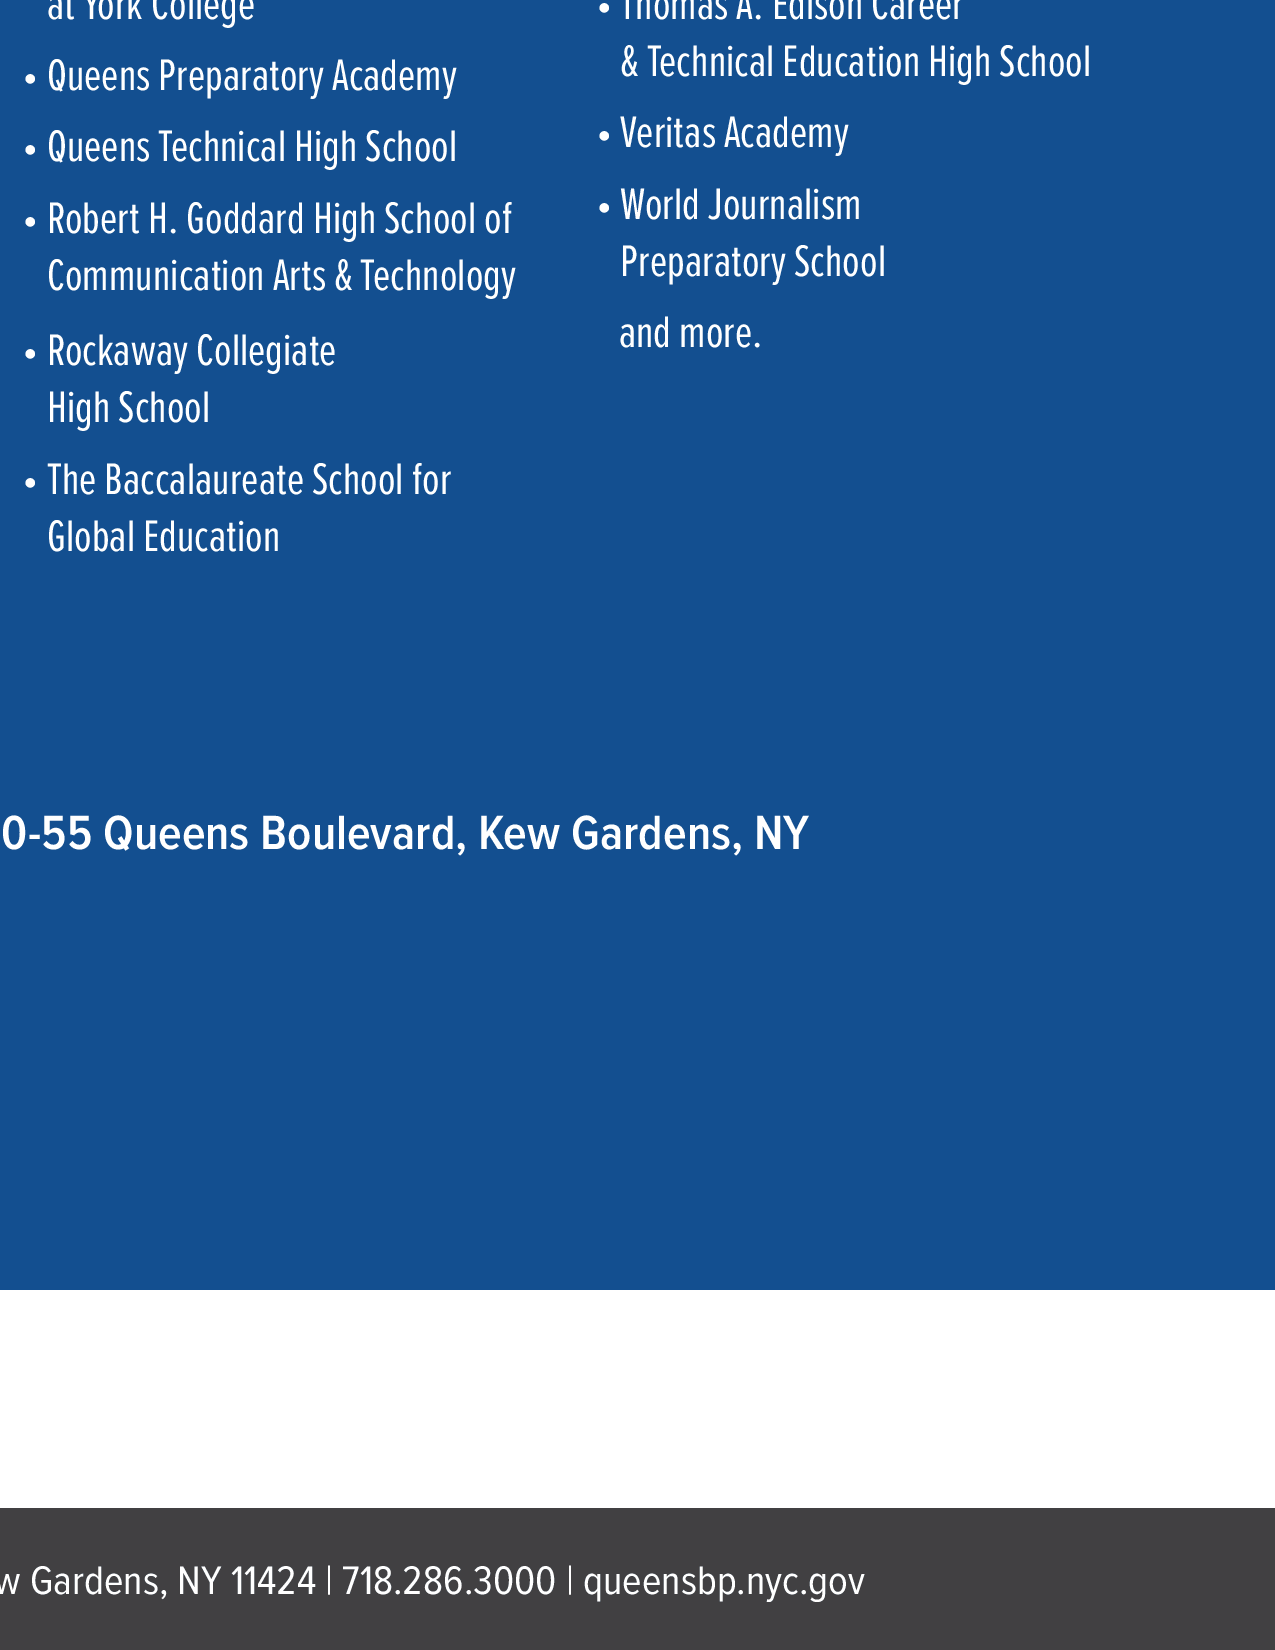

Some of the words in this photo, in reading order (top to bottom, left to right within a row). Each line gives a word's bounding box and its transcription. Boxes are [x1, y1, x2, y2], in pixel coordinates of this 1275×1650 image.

[622, 45, 638, 77] &
[648, 45, 772, 77] Technical
[785, 45, 918, 77] Education
[931, 45, 989, 85] High
[1000, 45, 1089, 77] School
[50, 202, 139, 234] Robert
[151, 202, 176, 234] H.
[188, 202, 302, 234] Goddard
[316, 202, 374, 242] High
[385, 202, 474, 234] School
[486, 202, 512, 234] of
[49, 259, 262, 291] Communication
[273, 259, 325, 291] Arts
[336, 259, 352, 291] &
[361, 259, 516, 299] Technology
[620, 316, 668, 348] and
[681, 324, 760, 348] more.
[48, 463, 95, 495] The
[107, 463, 303, 495] Baccalaureate
[313, 463, 401, 495] School
[413, 463, 451, 495] for
[49, 520, 133, 552] Global
[146, 520, 278, 552] Education
[105, 815, 248, 851] Queens
[263, 816, 465, 855] Boulevard,
[481, 816, 560, 850] Kew
[573, 815, 741, 855] Gardens,
[757, 816, 809, 849] NY
[32, 1566, 166, 1599] Gardens,
[180, 1566, 221, 1594] NY
[232, 1566, 315, 1594] 11424
[343, 1566, 554, 1595] 718.286.3000
[585, 1566, 865, 1602] queensbp.nyc.gov
